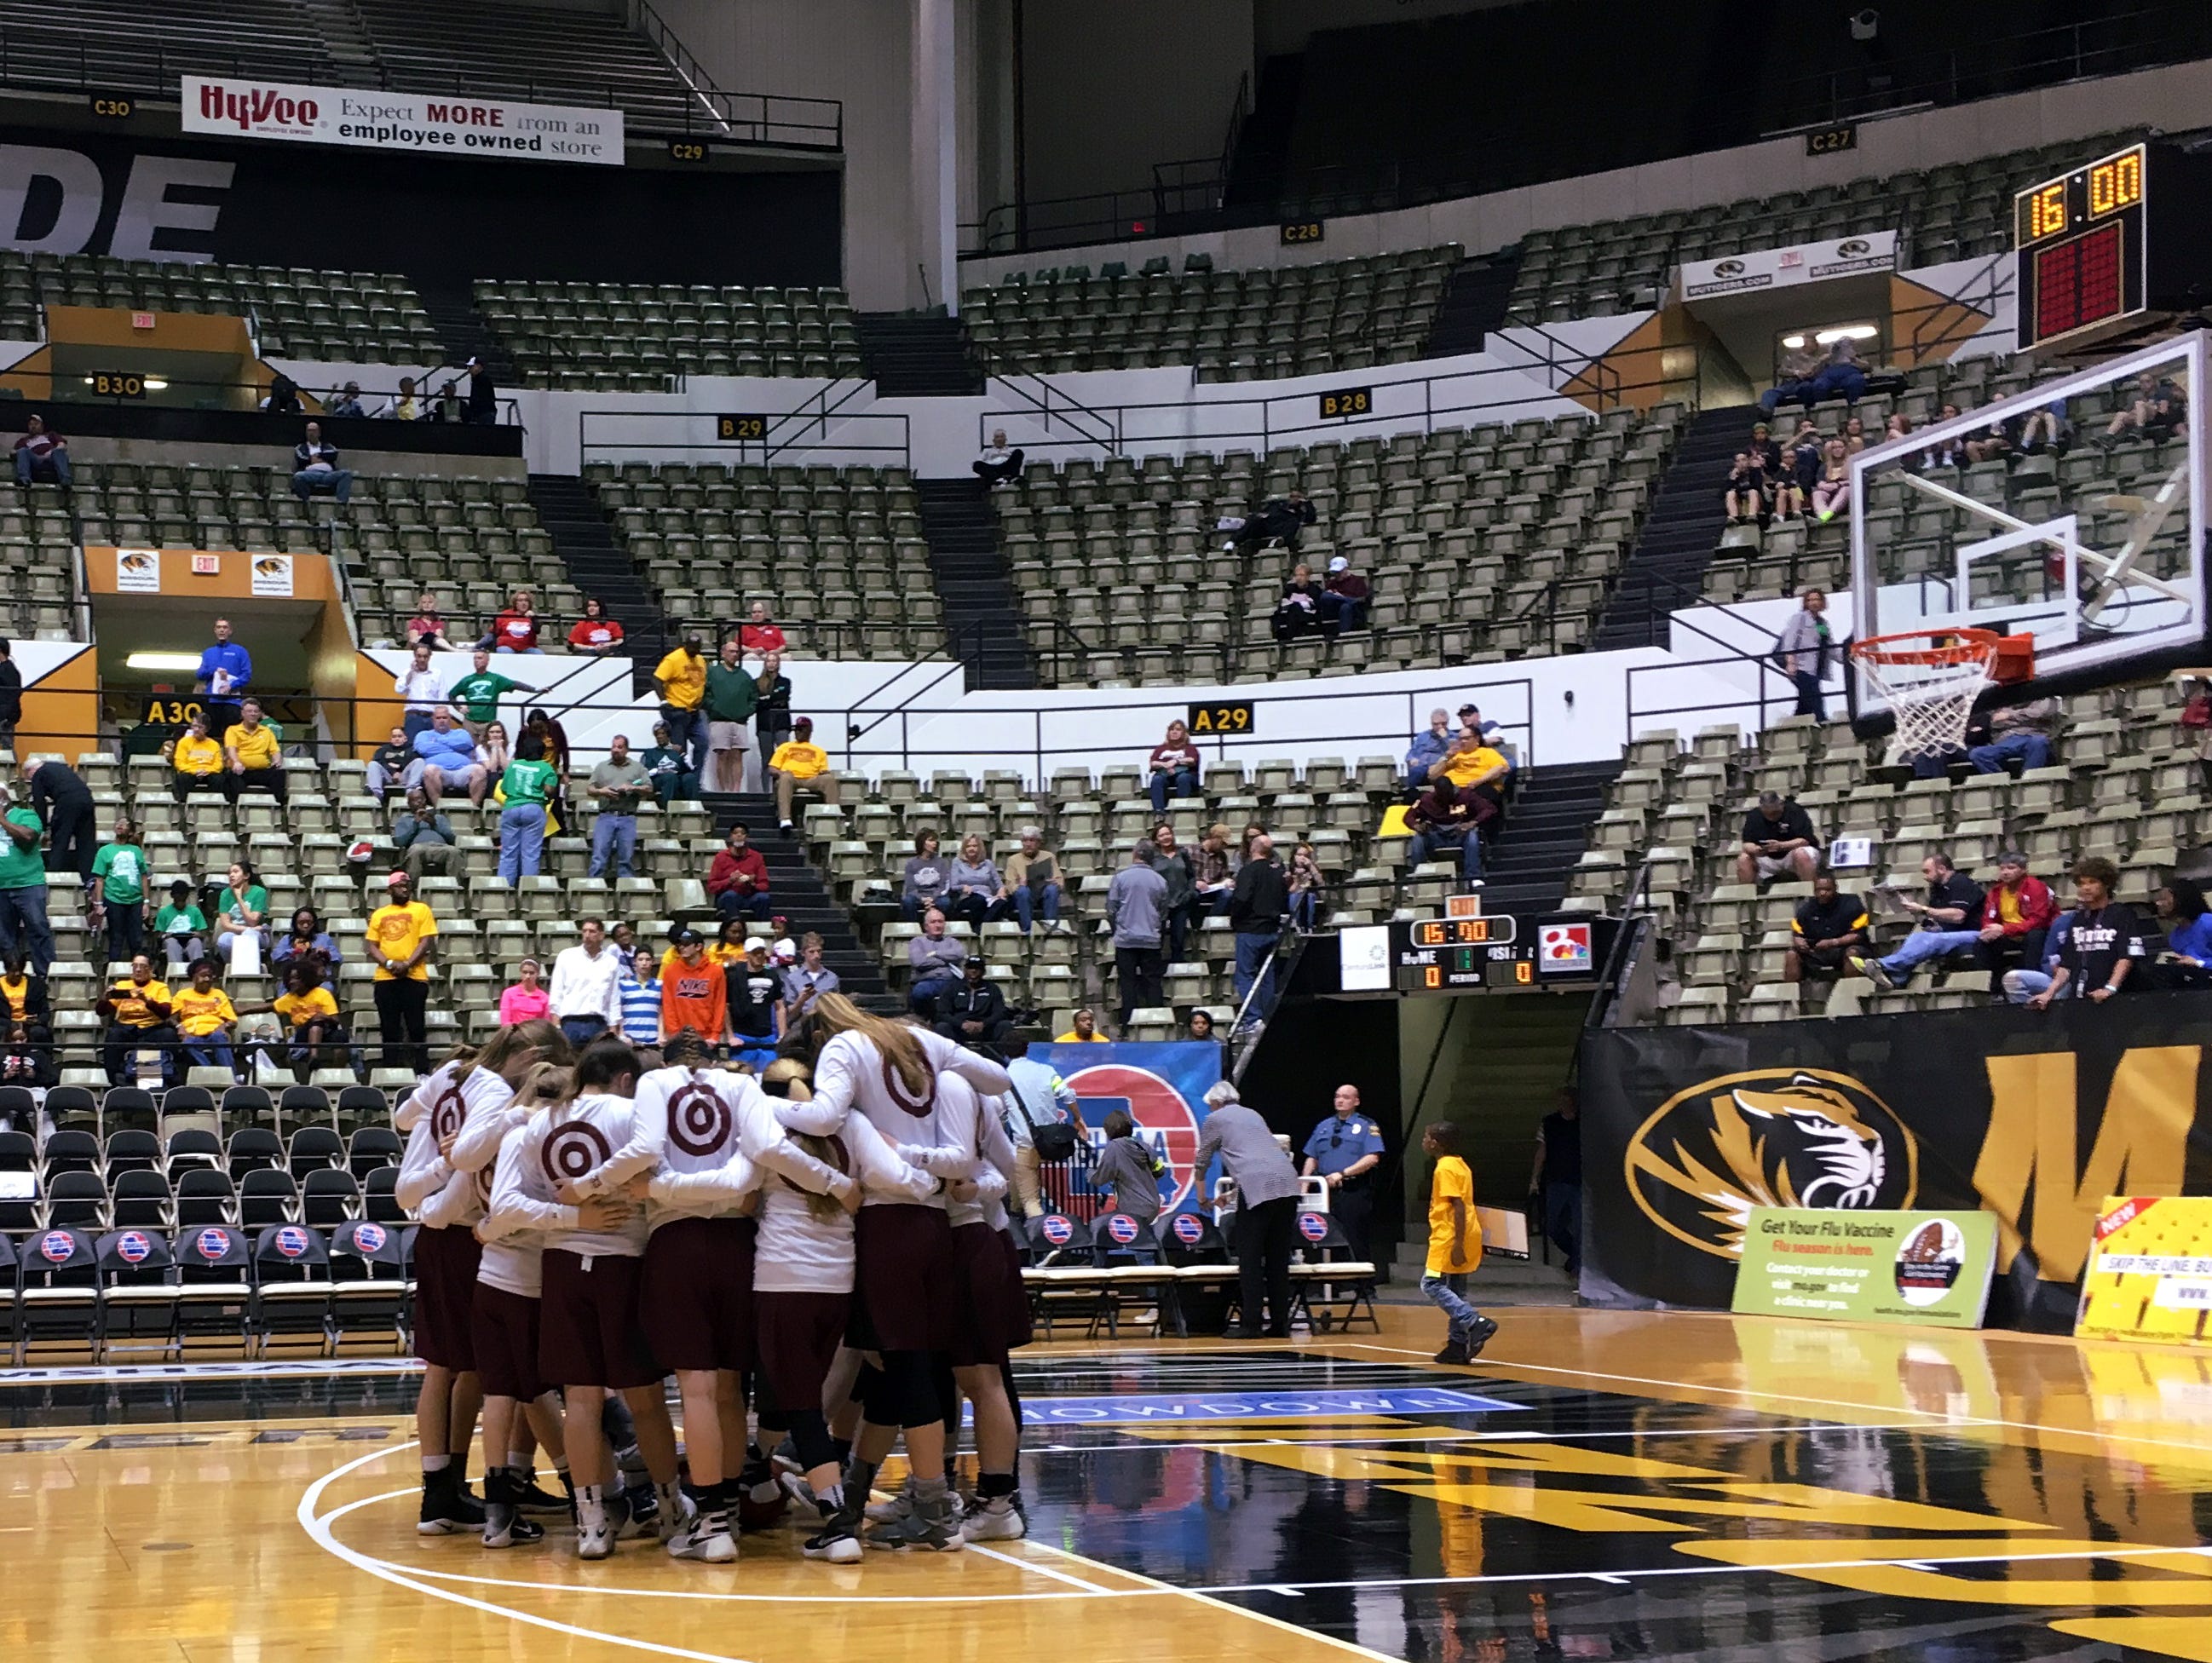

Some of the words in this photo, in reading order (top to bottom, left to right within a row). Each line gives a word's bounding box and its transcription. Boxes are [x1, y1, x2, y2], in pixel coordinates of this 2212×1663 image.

[95, 100, 130, 116] C30
[200, 85, 319, 129] HyVee
[341, 99, 414, 123] Expect
[427, 104, 504, 127] MORE
[517, 117, 567, 134] from
[575, 122, 601, 135] an
[339, 124, 457, 146] employee
[464, 134, 542, 152] owned
[550, 141, 603, 157] store
[1813, 129, 1850, 151] C27
[673, 144, 703, 159] C29
[1285, 223, 1319, 240] C28
[97, 376, 141, 395] B30
[1325, 393, 1367, 415] B28
[723, 420, 762, 436] B29
[196, 556, 215, 571] EXIT
[147, 701, 203, 724] A30
[1195, 708, 1248, 731] A29
[677, 979, 710, 993] NIKE
[2100, 1202, 2136, 1234] NEW
[1761, 1219, 1785, 1234] Get
[1789, 1220, 1818, 1235] Your
[1820, 1221, 1841, 1236] Flu
[1844, 1222, 1895, 1238] Vaccine
[1772, 1240, 1791, 1253] Flu
[1792, 1243, 1832, 1254] season
[1834, 1243, 1843, 1255] is
[1846, 1243, 1874, 1256] here.
[1766, 1262, 1802, 1275] Contact
[1802, 1265, 1824, 1276] your
[1826, 1265, 1858, 1276] doctor
[1858, 1268, 1870, 1277] or
[2108, 1257, 2134, 1269] SKIP
[2137, 1258, 2160, 1270] THE
[1771, 1279, 1792, 1290] visit
[1792, 1281, 1827, 1293] mo.gov
[1827, 1282, 1839, 1292] to
[1839, 1281, 1860, 1293] find
[1781, 1295, 1806, 1308] clinic
[1806, 1298, 1826, 1309] near
